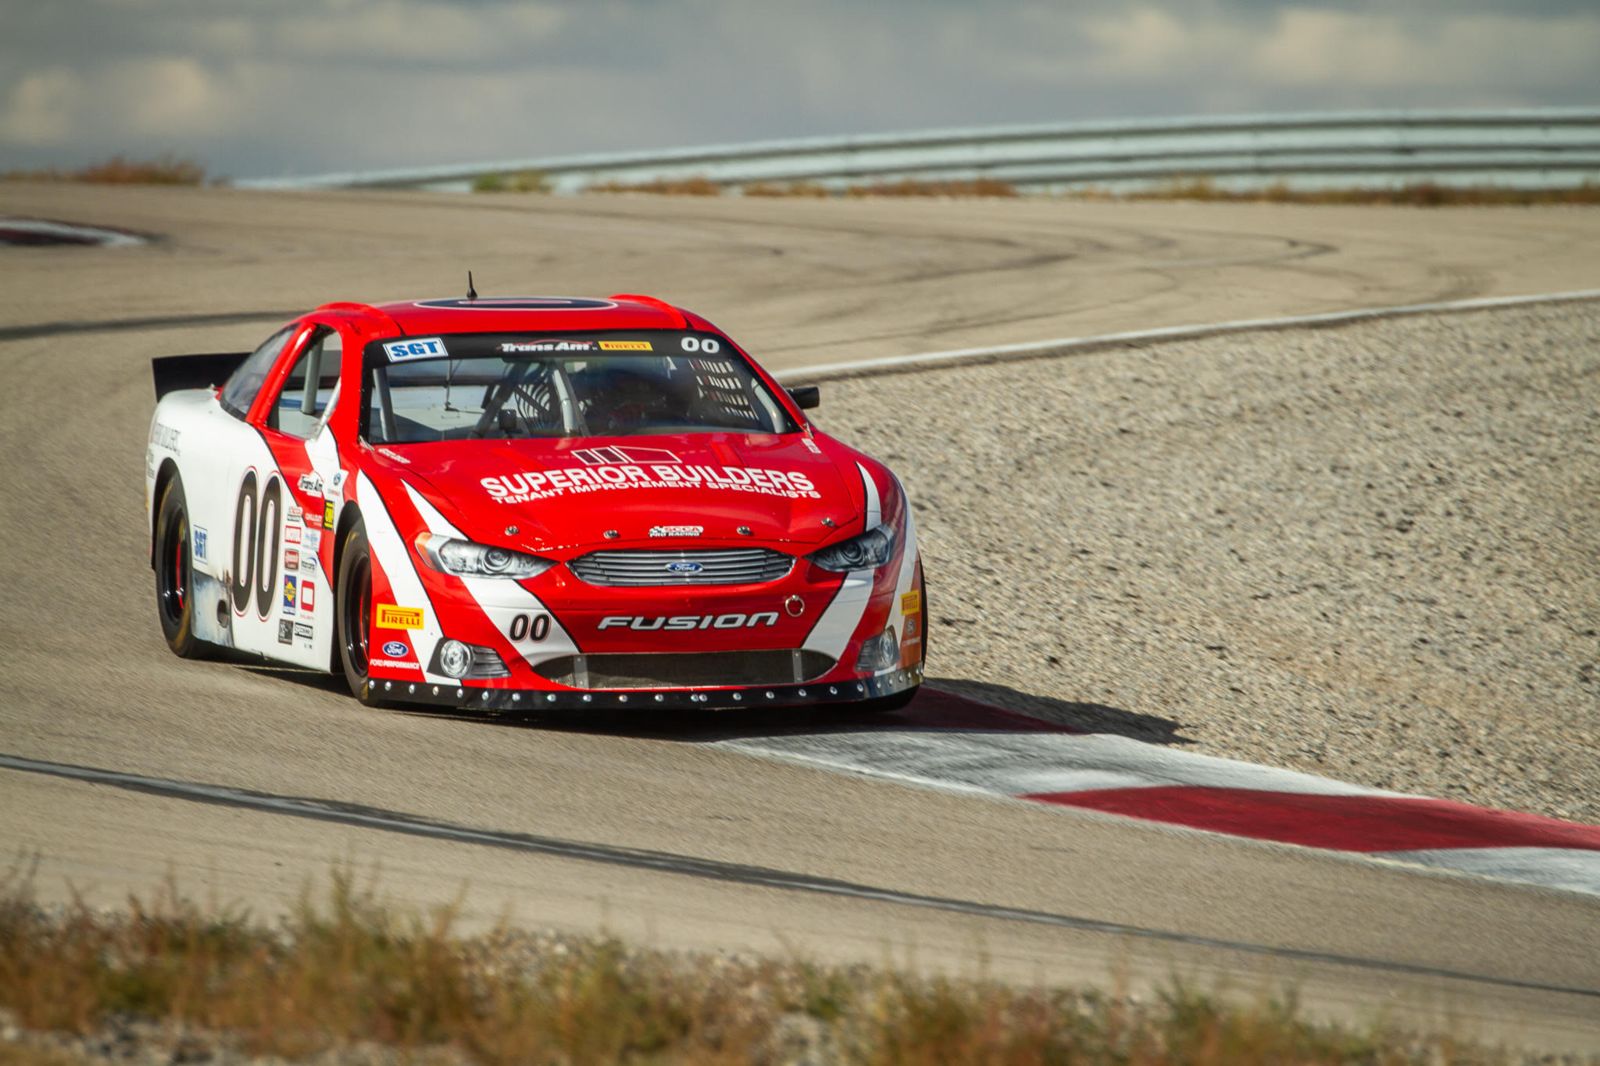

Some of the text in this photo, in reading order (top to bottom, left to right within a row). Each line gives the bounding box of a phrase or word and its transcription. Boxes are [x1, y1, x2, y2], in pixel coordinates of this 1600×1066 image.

[391, 341, 438, 357] SGT
[501, 340, 590, 352] Trans Am
[681, 337, 719, 353] 00
[480, 465, 815, 497] SUPERIOR BUILDERS
[492, 480, 821, 504] TENANT IMPROVEMENT SPECIALISTS
[233, 468, 282, 620] 00
[382, 609, 420, 625] PIRELLI
[597, 611, 779, 630] FUSION
[510, 613, 551, 642] 00
